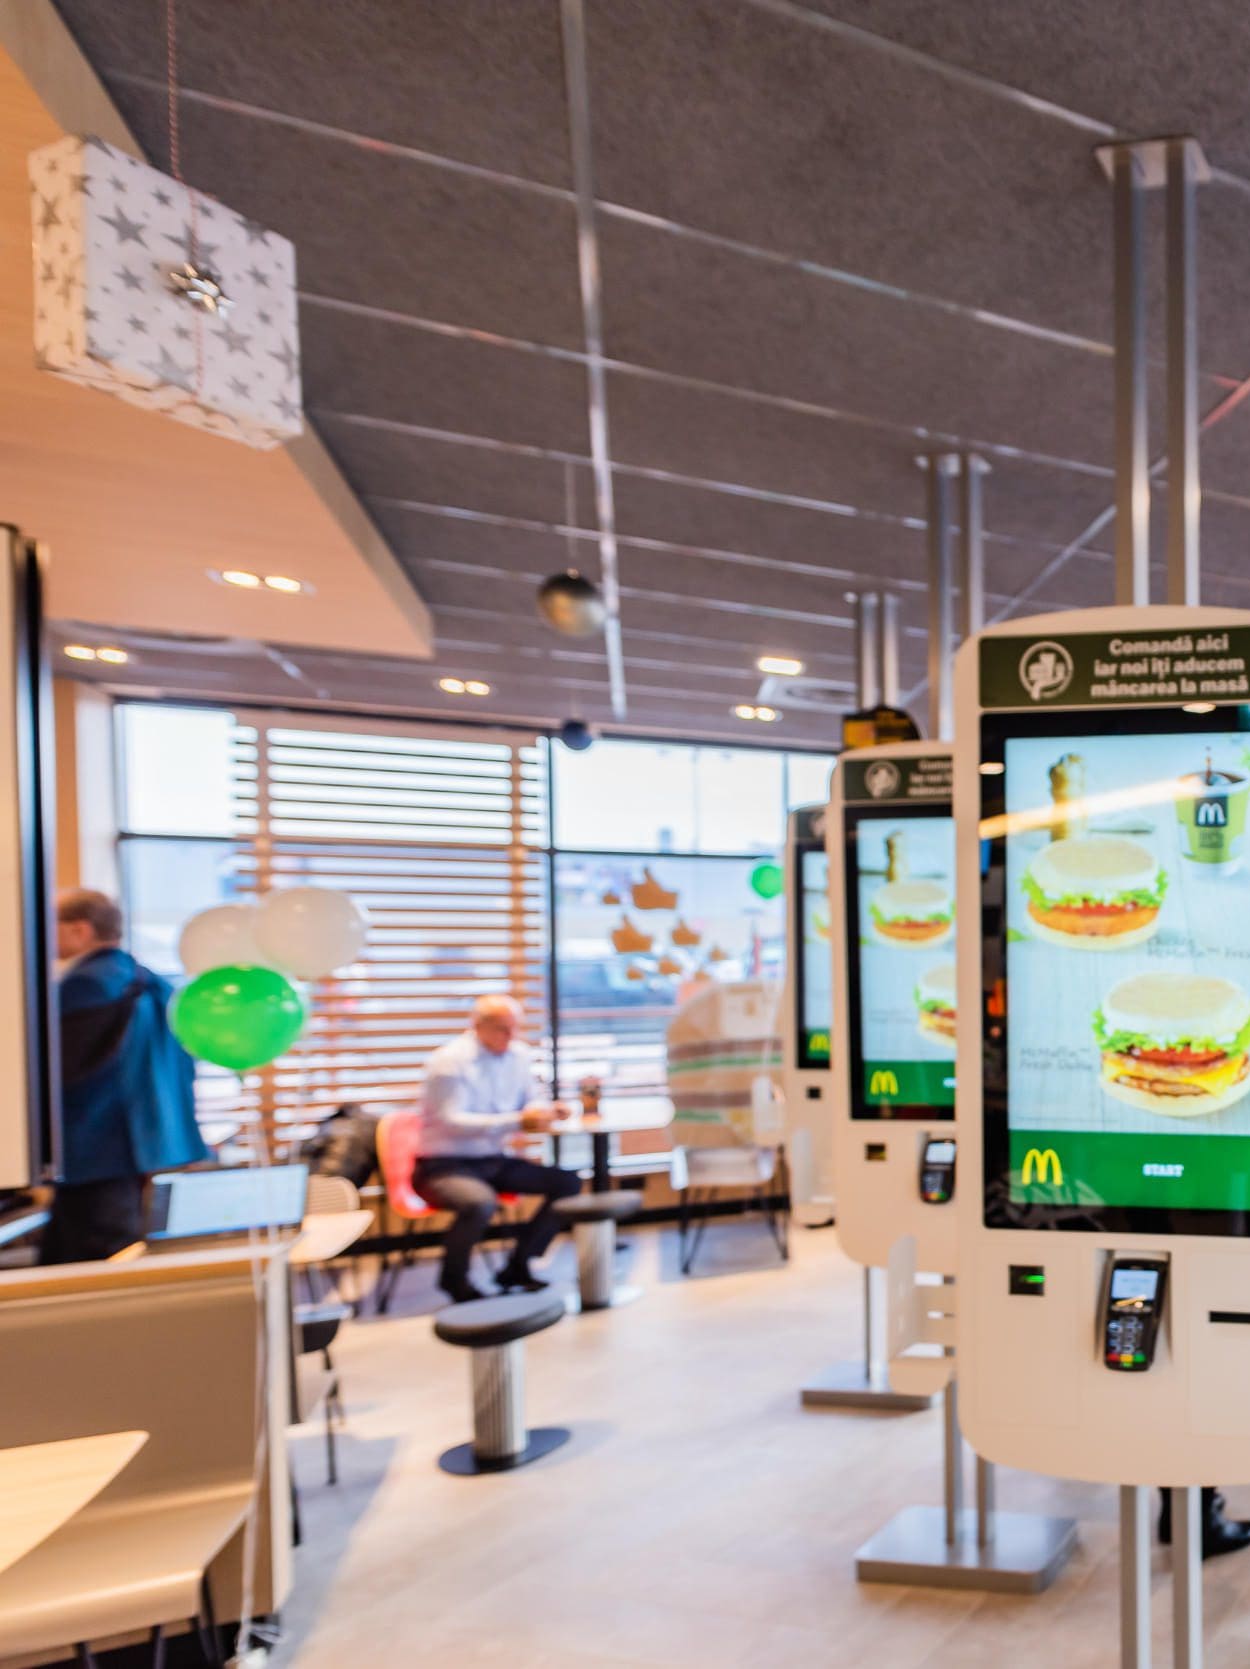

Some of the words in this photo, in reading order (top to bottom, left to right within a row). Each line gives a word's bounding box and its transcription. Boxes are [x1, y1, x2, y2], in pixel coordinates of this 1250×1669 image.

[1094, 659, 1118, 676] iar
[1120, 657, 1149, 676] noi
[1174, 656, 1245, 675] aducem
[1180, 677, 1198, 694] la
